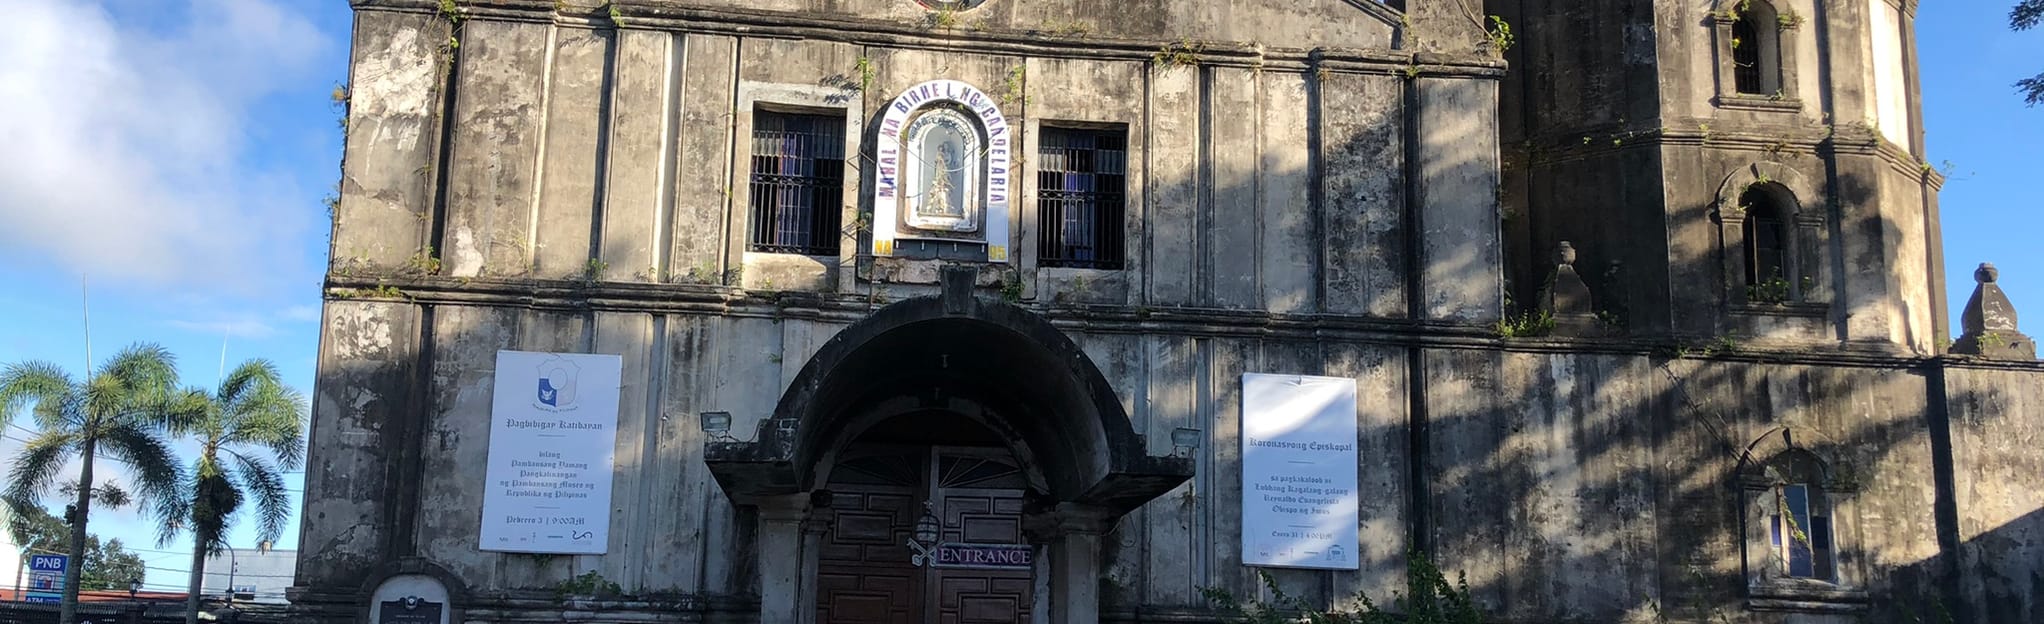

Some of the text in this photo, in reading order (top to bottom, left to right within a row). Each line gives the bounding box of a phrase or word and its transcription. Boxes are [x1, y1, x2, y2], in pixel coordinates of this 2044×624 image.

[960, 86, 980, 107] NG
[881, 118, 900, 137] NA
[981, 106, 1006, 202] CANDELARIA
[879, 149, 896, 197] MAHAL
[36, 557, 61, 569] PNB
[940, 548, 1031, 564] ENTRANCE
